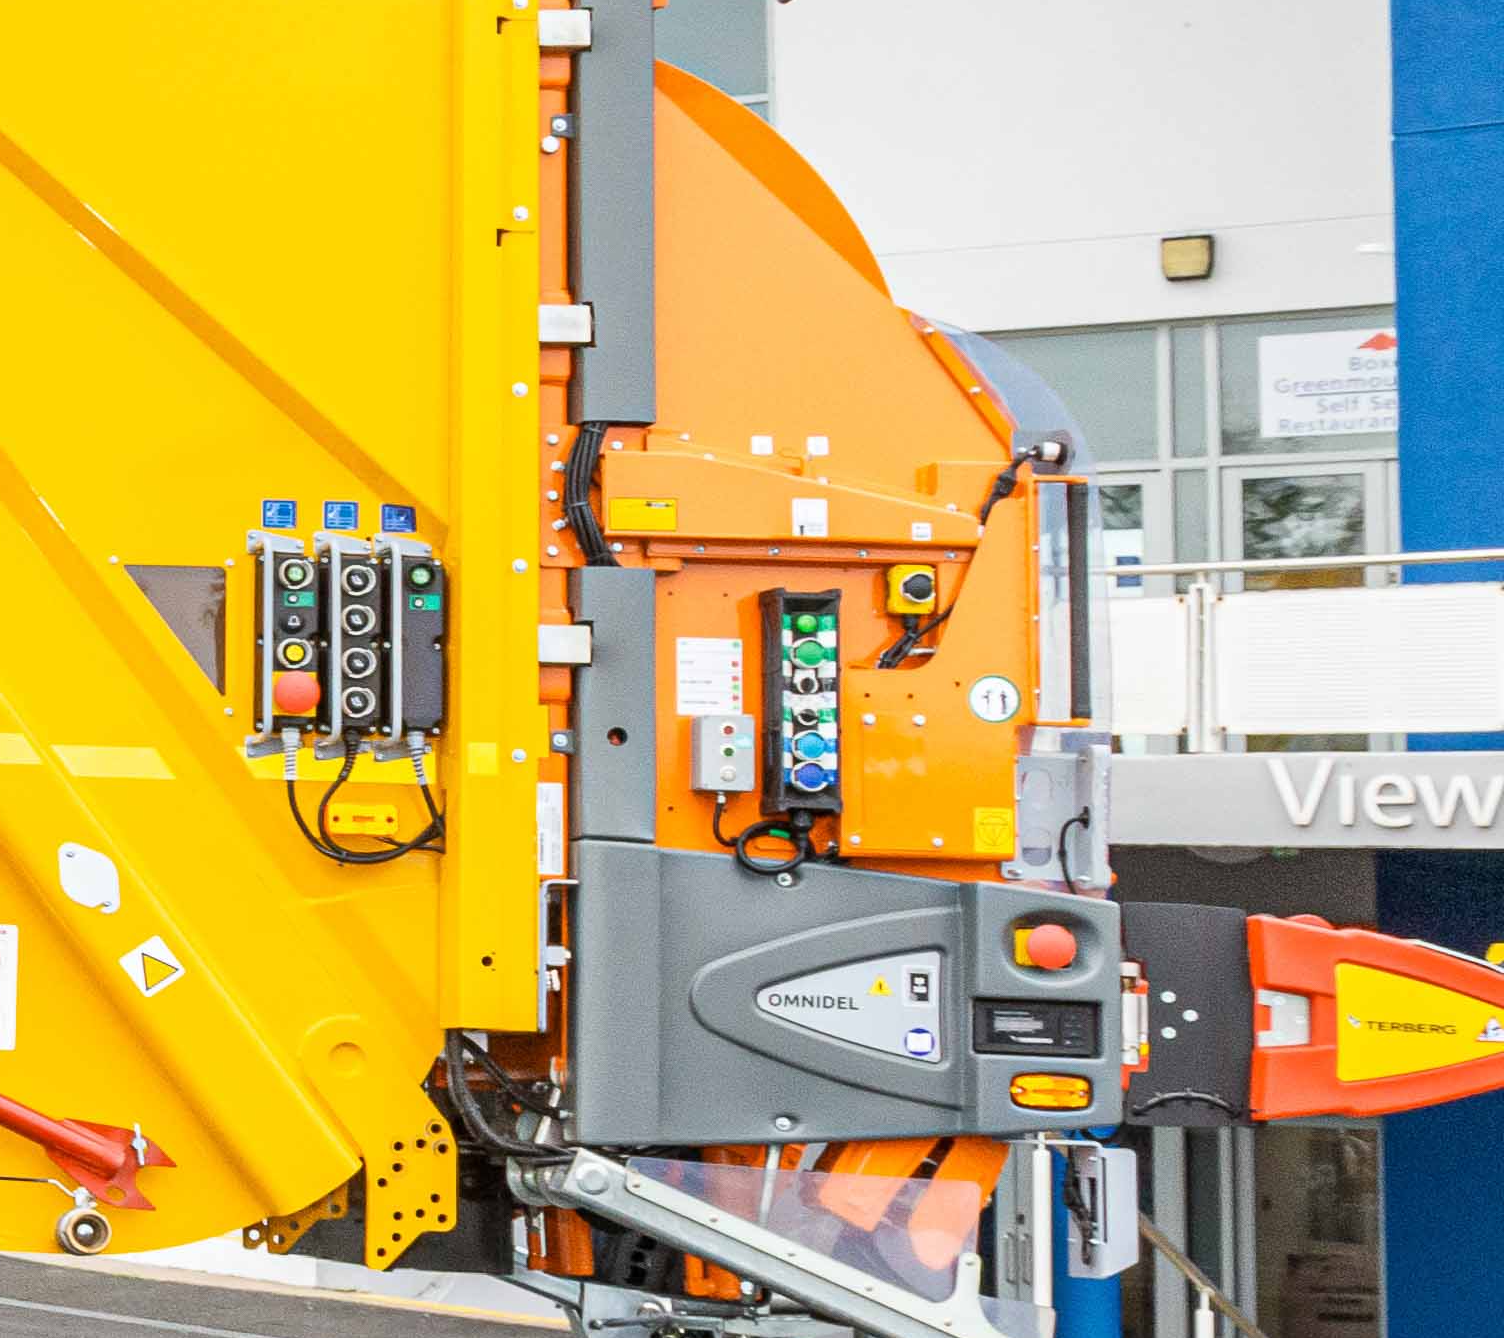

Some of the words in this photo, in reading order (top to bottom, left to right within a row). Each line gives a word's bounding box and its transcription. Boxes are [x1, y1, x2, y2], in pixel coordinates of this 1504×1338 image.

[1316, 397, 1360, 414] Self
[768, 993, 859, 1011] OMNIDEL
[1366, 1020, 1457, 1034] TERBERG
